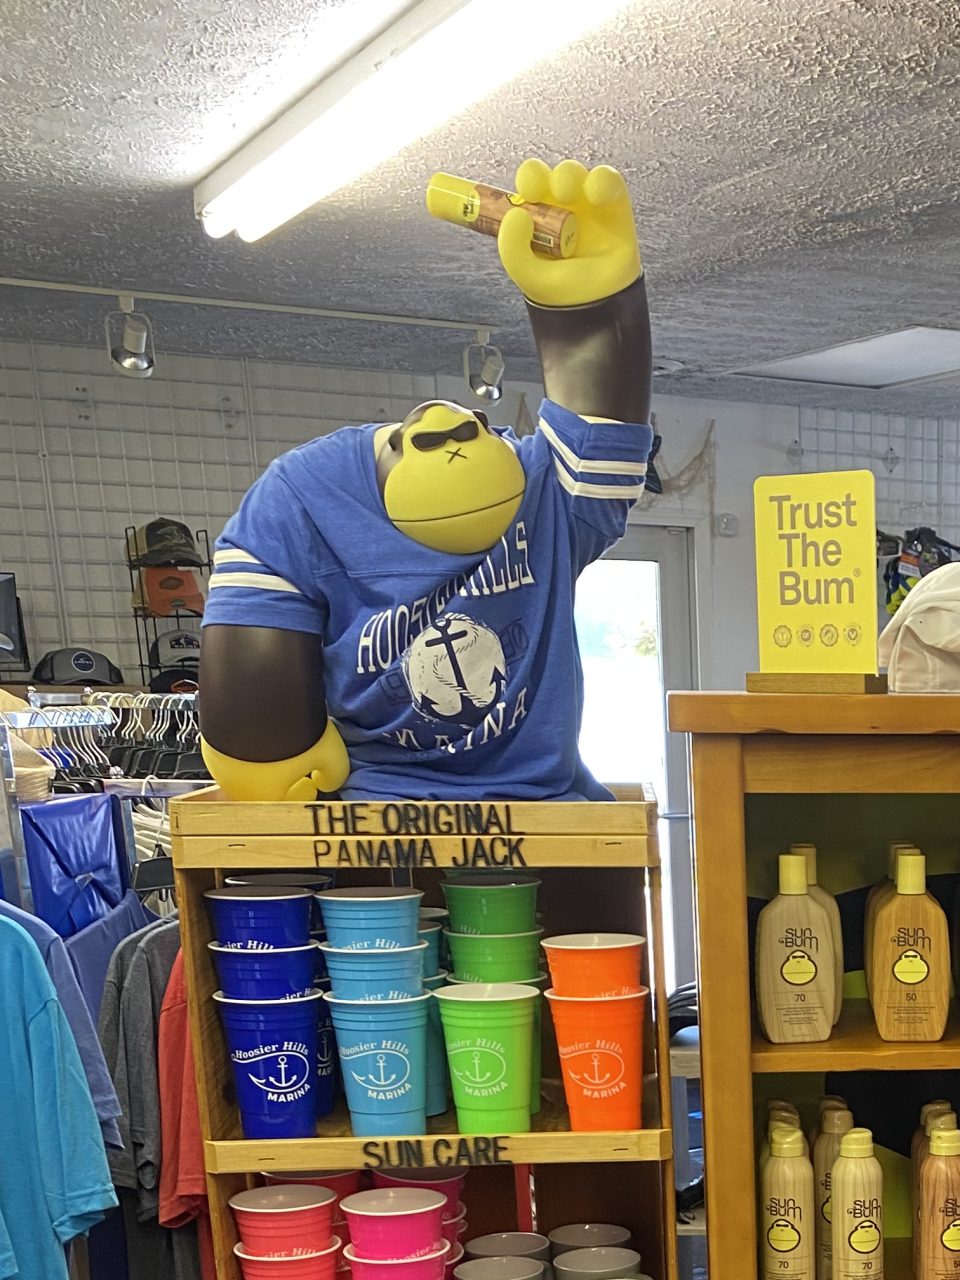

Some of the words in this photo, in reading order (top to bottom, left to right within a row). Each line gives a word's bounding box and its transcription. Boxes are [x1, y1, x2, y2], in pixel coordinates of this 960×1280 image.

[769, 493, 857, 530] Trust
[778, 532, 842, 567] The
[304, 803, 371, 834] THE
[382, 803, 526, 835] ORIGINAL
[313, 838, 437, 867] PANAMA
[452, 836, 528, 867] JACK
[795, 993, 806, 1002] 70
[906, 992, 917, 1001] 50
[235, 1043, 279, 1059] Hoosier
[283, 1041, 309, 1056] Hills
[340, 1042, 377, 1056] Hoosier
[381, 1040, 409, 1055] Hills
[476, 1038, 505, 1053] Hills
[596, 1039, 623, 1054] Hills
[267, 1082, 311, 1103] MARINA
[367, 1082, 412, 1101] MARINA
[464, 1081, 509, 1097] MARINA
[582, 1081, 627, 1099] MARINA
[363, 1140, 424, 1169] SUN
[432, 1136, 513, 1166] CARE
[777, 1260, 789, 1269] 70
[862, 1262, 873, 1270] 70
